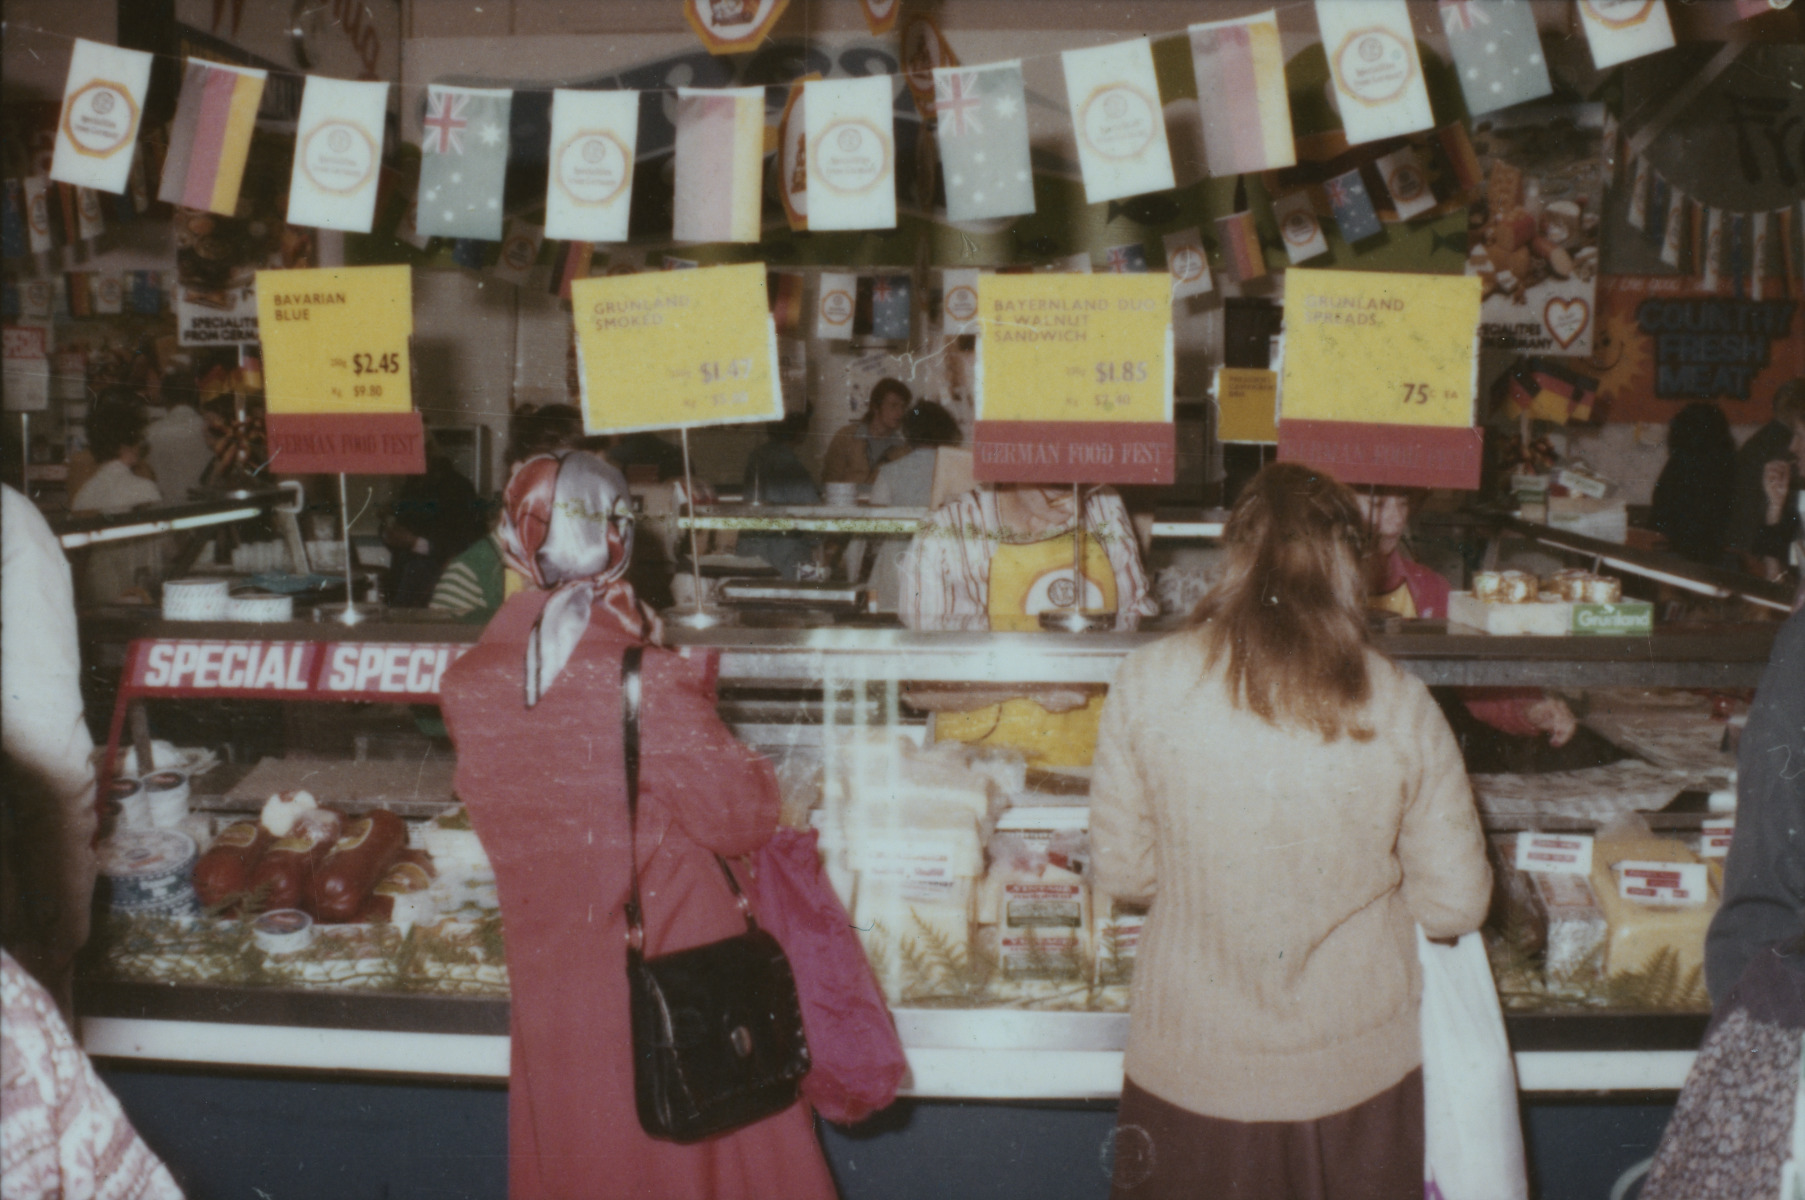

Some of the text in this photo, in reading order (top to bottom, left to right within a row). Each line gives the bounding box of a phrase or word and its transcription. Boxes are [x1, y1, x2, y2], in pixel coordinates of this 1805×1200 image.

[274, 293, 346, 306] BAVARIAN
[994, 298, 1155, 312] BAYERNLAND DUO
[275, 309, 310, 321] BLUE
[595, 313, 664, 331] SMOKED
[1014, 314, 1090, 327] WALNUT
[1304, 310, 1377, 326] SPREADS
[1638, 301, 1794, 333] COUNTRY
[184, 330, 219, 341] FROM
[994, 329, 1087, 343] SANDWICH
[1659, 334, 1766, 363] FRESH
[353, 353, 399, 376] $2.45
[700, 358, 753, 384] $1.47
[1095, 361, 1148, 384] $1.85
[1659, 364, 1752, 396] MEAT
[354, 385, 382, 397] $9.80
[981, 442, 1168, 465] GERMAN FOOD FEST
[144, 644, 462, 693] SPECIAL SPECI
